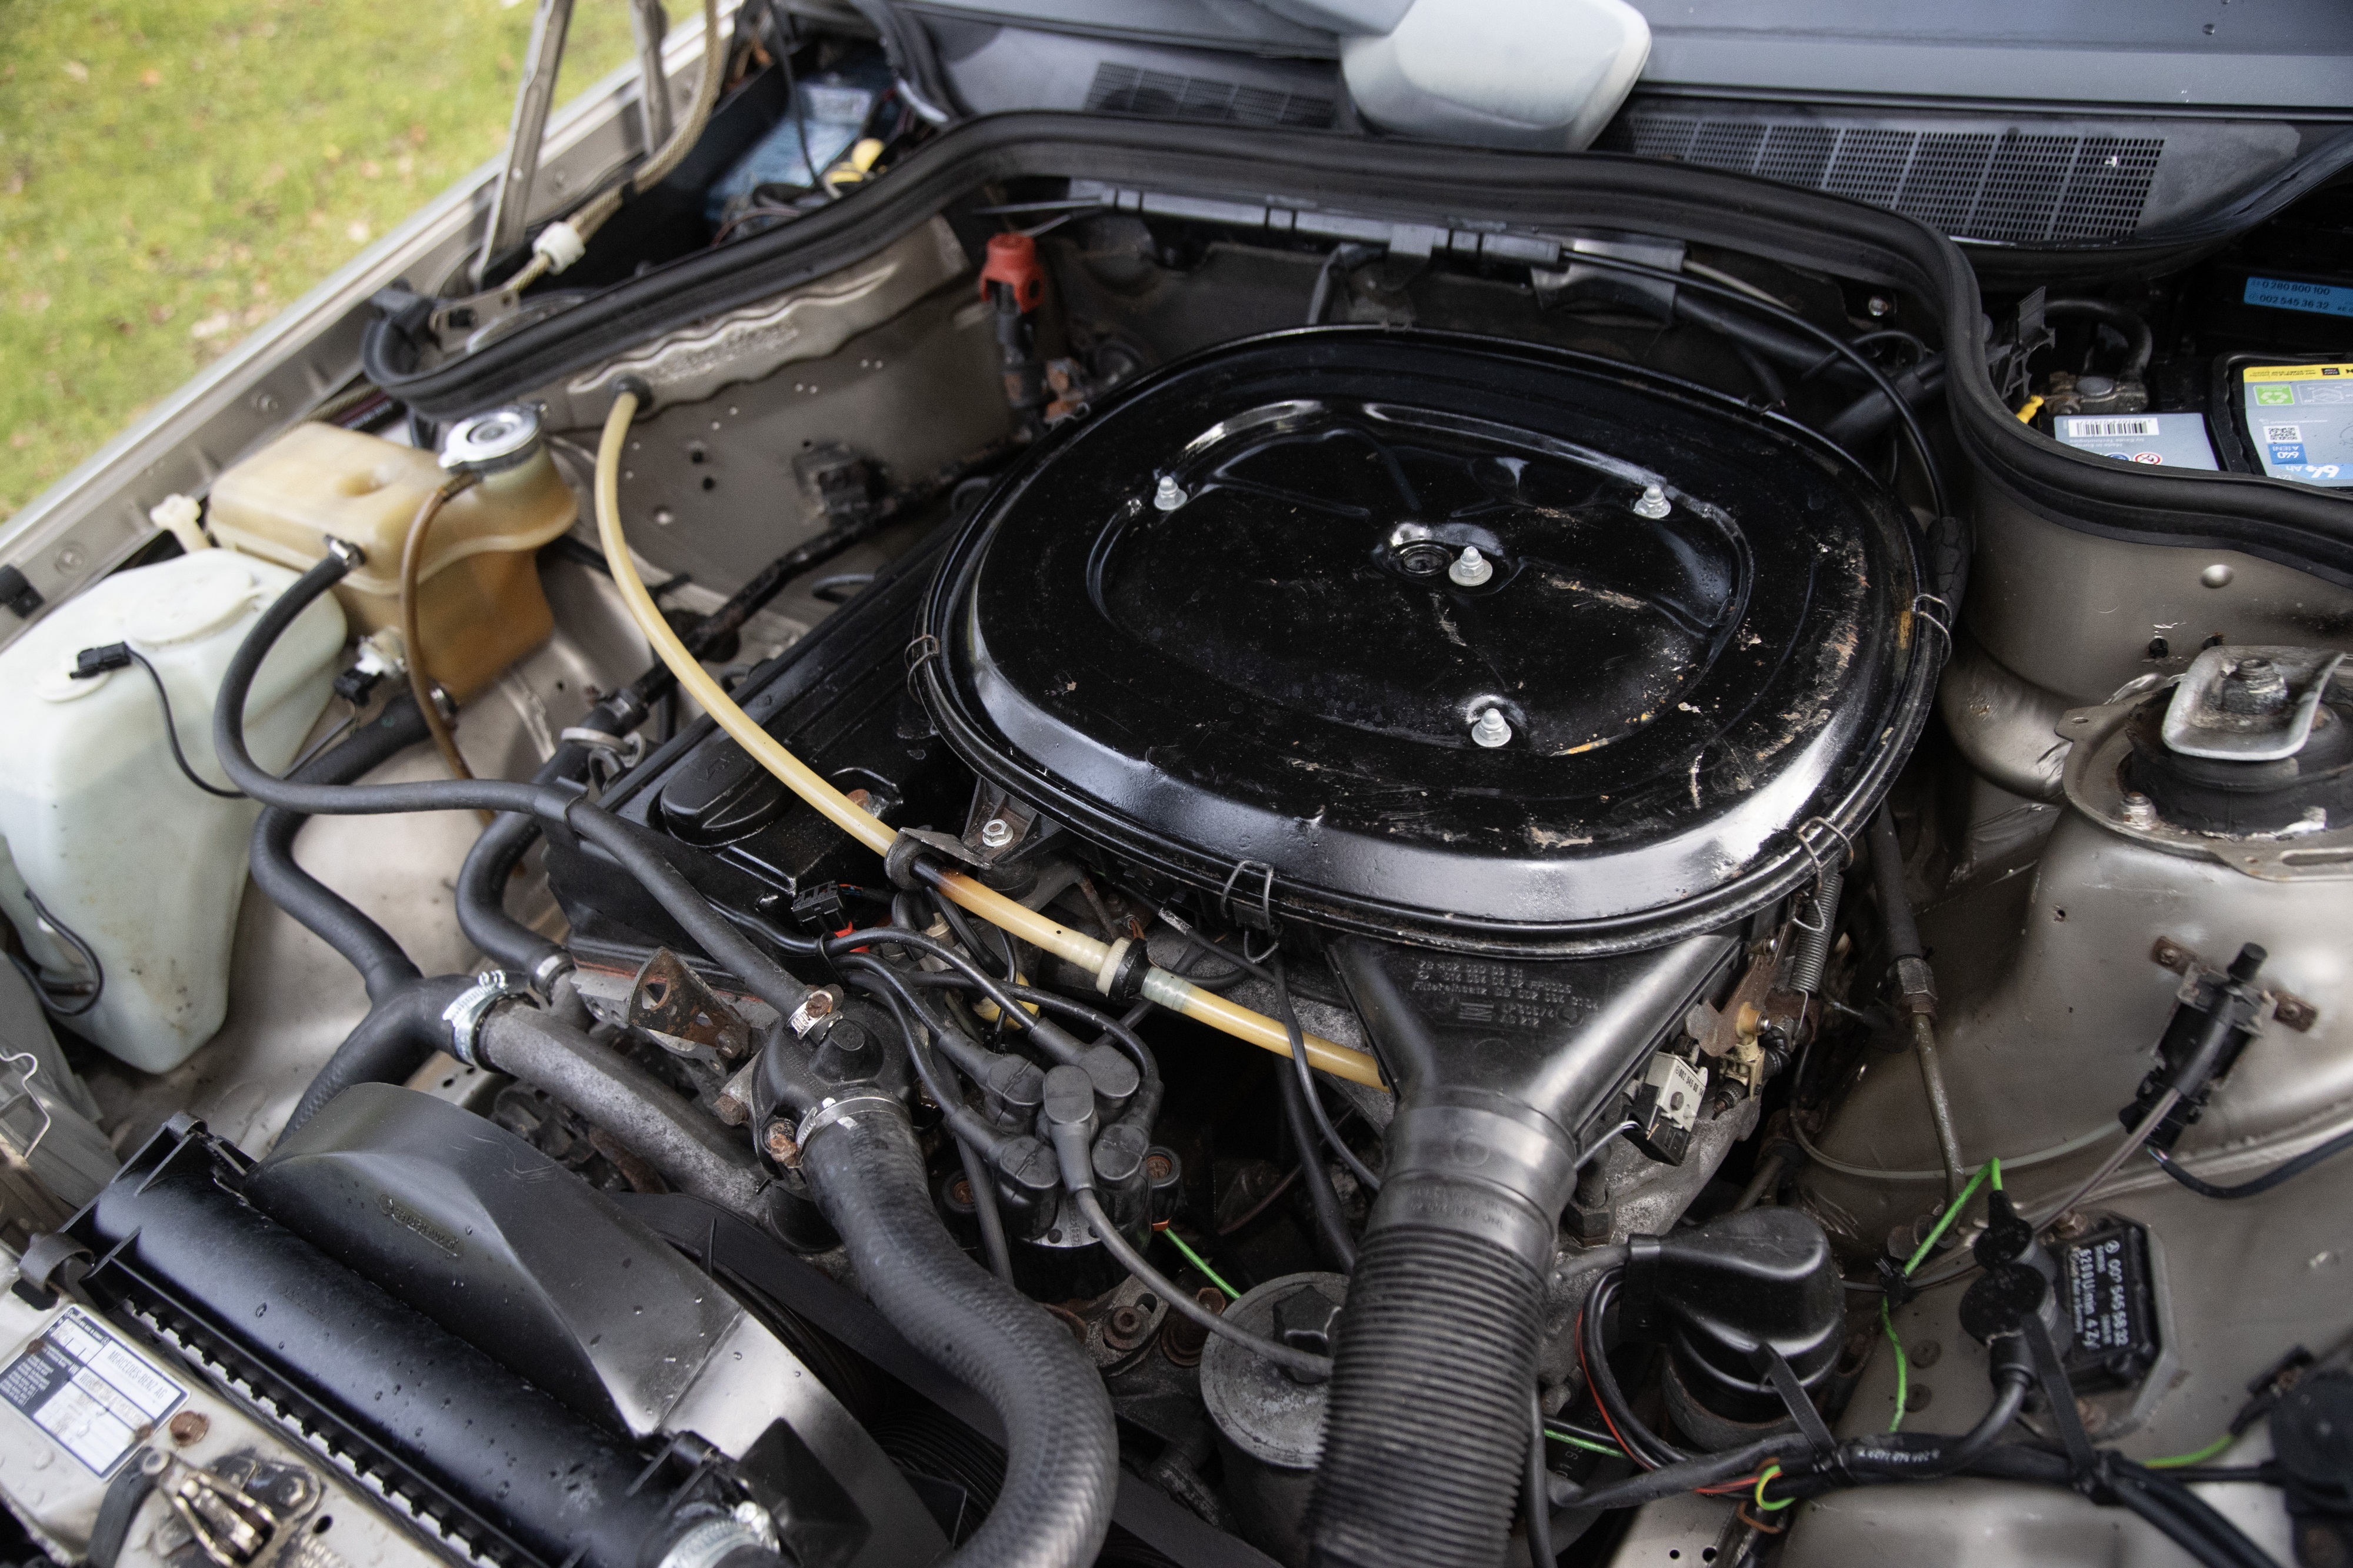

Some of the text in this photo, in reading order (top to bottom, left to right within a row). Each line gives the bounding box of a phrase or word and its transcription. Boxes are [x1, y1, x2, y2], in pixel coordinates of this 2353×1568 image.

[2271, 281, 2290, 291] 280
[2291, 284, 2311, 293] 800
[2314, 286, 2331, 296] 100
[2259, 294, 2279, 304] 002
[2280, 296, 2300, 306] 545
[2305, 465, 2339, 478] 64
[106, 1349, 159, 1392] MERCEDES-BENZ
[153, 1386, 168, 1400] AG
